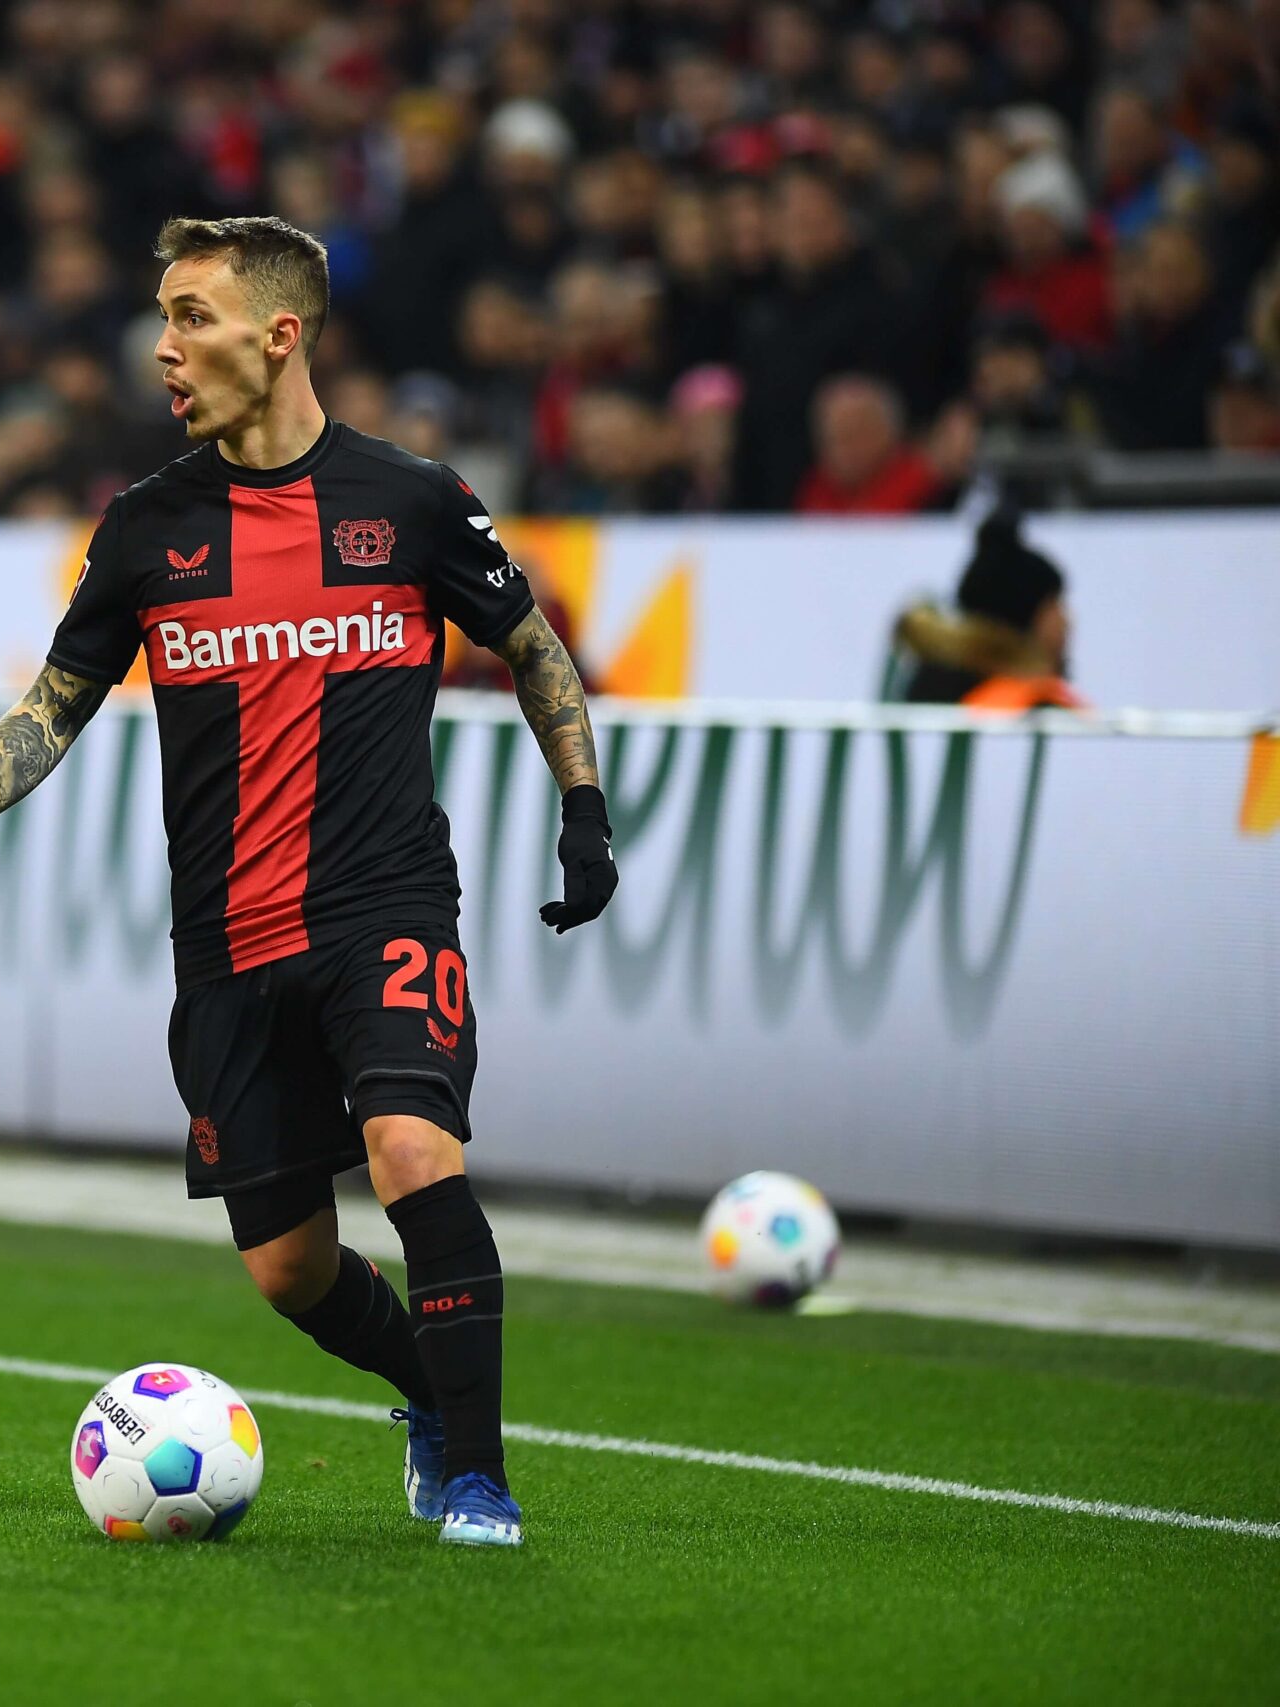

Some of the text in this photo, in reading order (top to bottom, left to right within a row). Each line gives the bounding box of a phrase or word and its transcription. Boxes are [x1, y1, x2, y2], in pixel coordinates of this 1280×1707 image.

[168, 569, 209, 581] CASTORE
[158, 600, 406, 670] Barmenia
[382, 938, 466, 1028] 20
